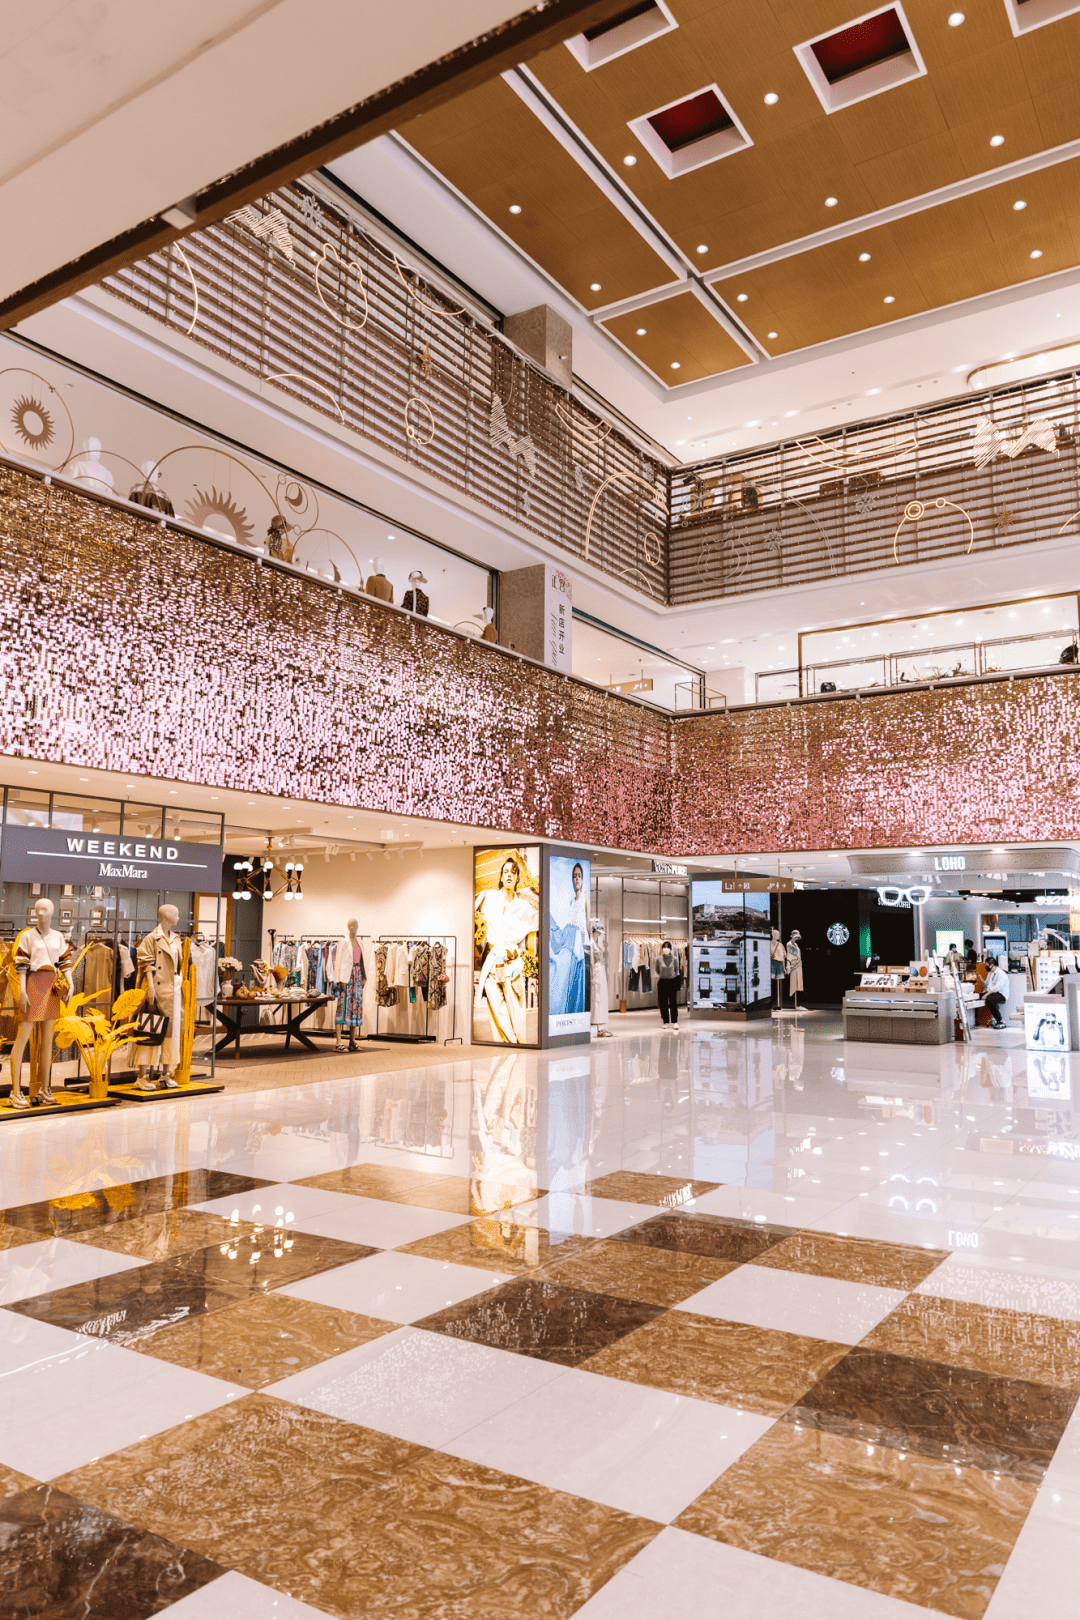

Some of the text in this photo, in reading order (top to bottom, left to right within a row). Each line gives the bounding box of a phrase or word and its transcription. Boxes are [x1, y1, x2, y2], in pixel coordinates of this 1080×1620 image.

[66, 838, 179, 860] WEEKEND
[98, 862, 148, 879] MaxMara
[934, 856, 966, 871] LOHO
